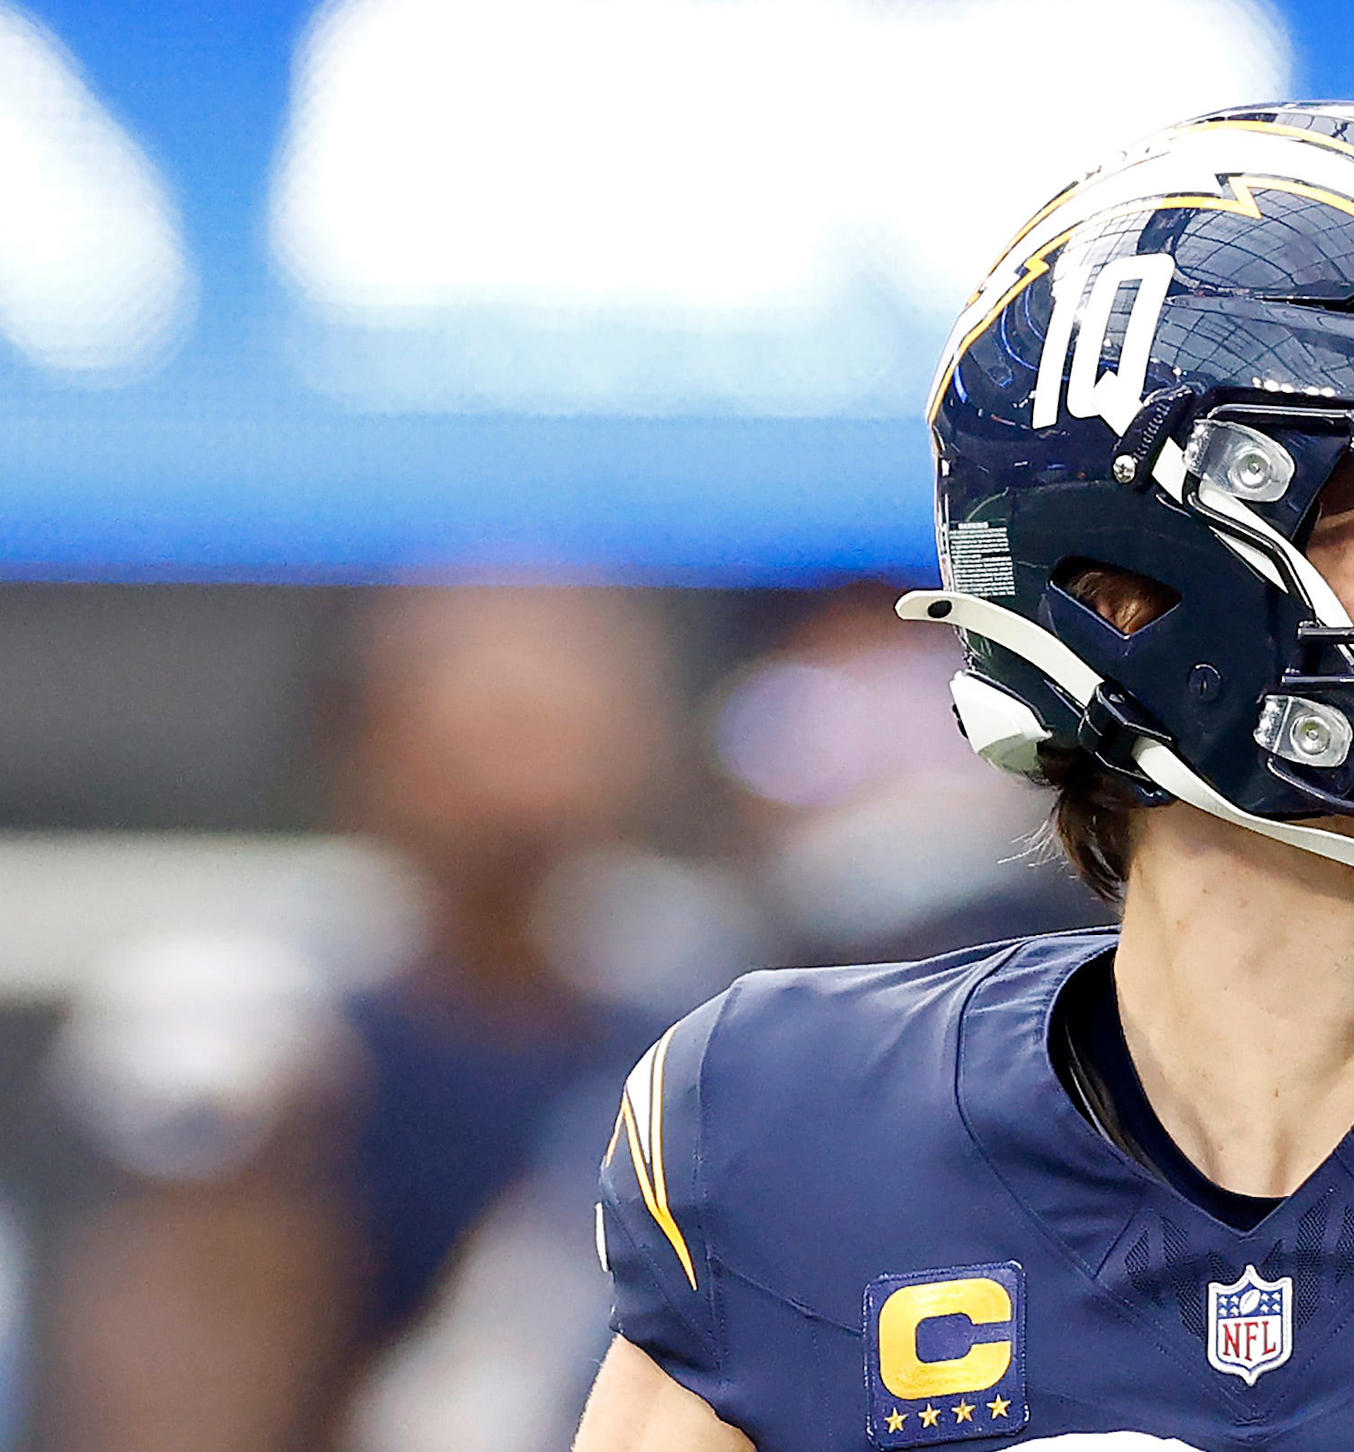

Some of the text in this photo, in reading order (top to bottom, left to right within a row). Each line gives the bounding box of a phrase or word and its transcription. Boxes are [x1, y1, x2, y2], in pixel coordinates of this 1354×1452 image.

[1033, 252, 1176, 430] 10
[878, 1277, 1012, 1400] C
[1222, 1320, 1277, 1362] NFL
